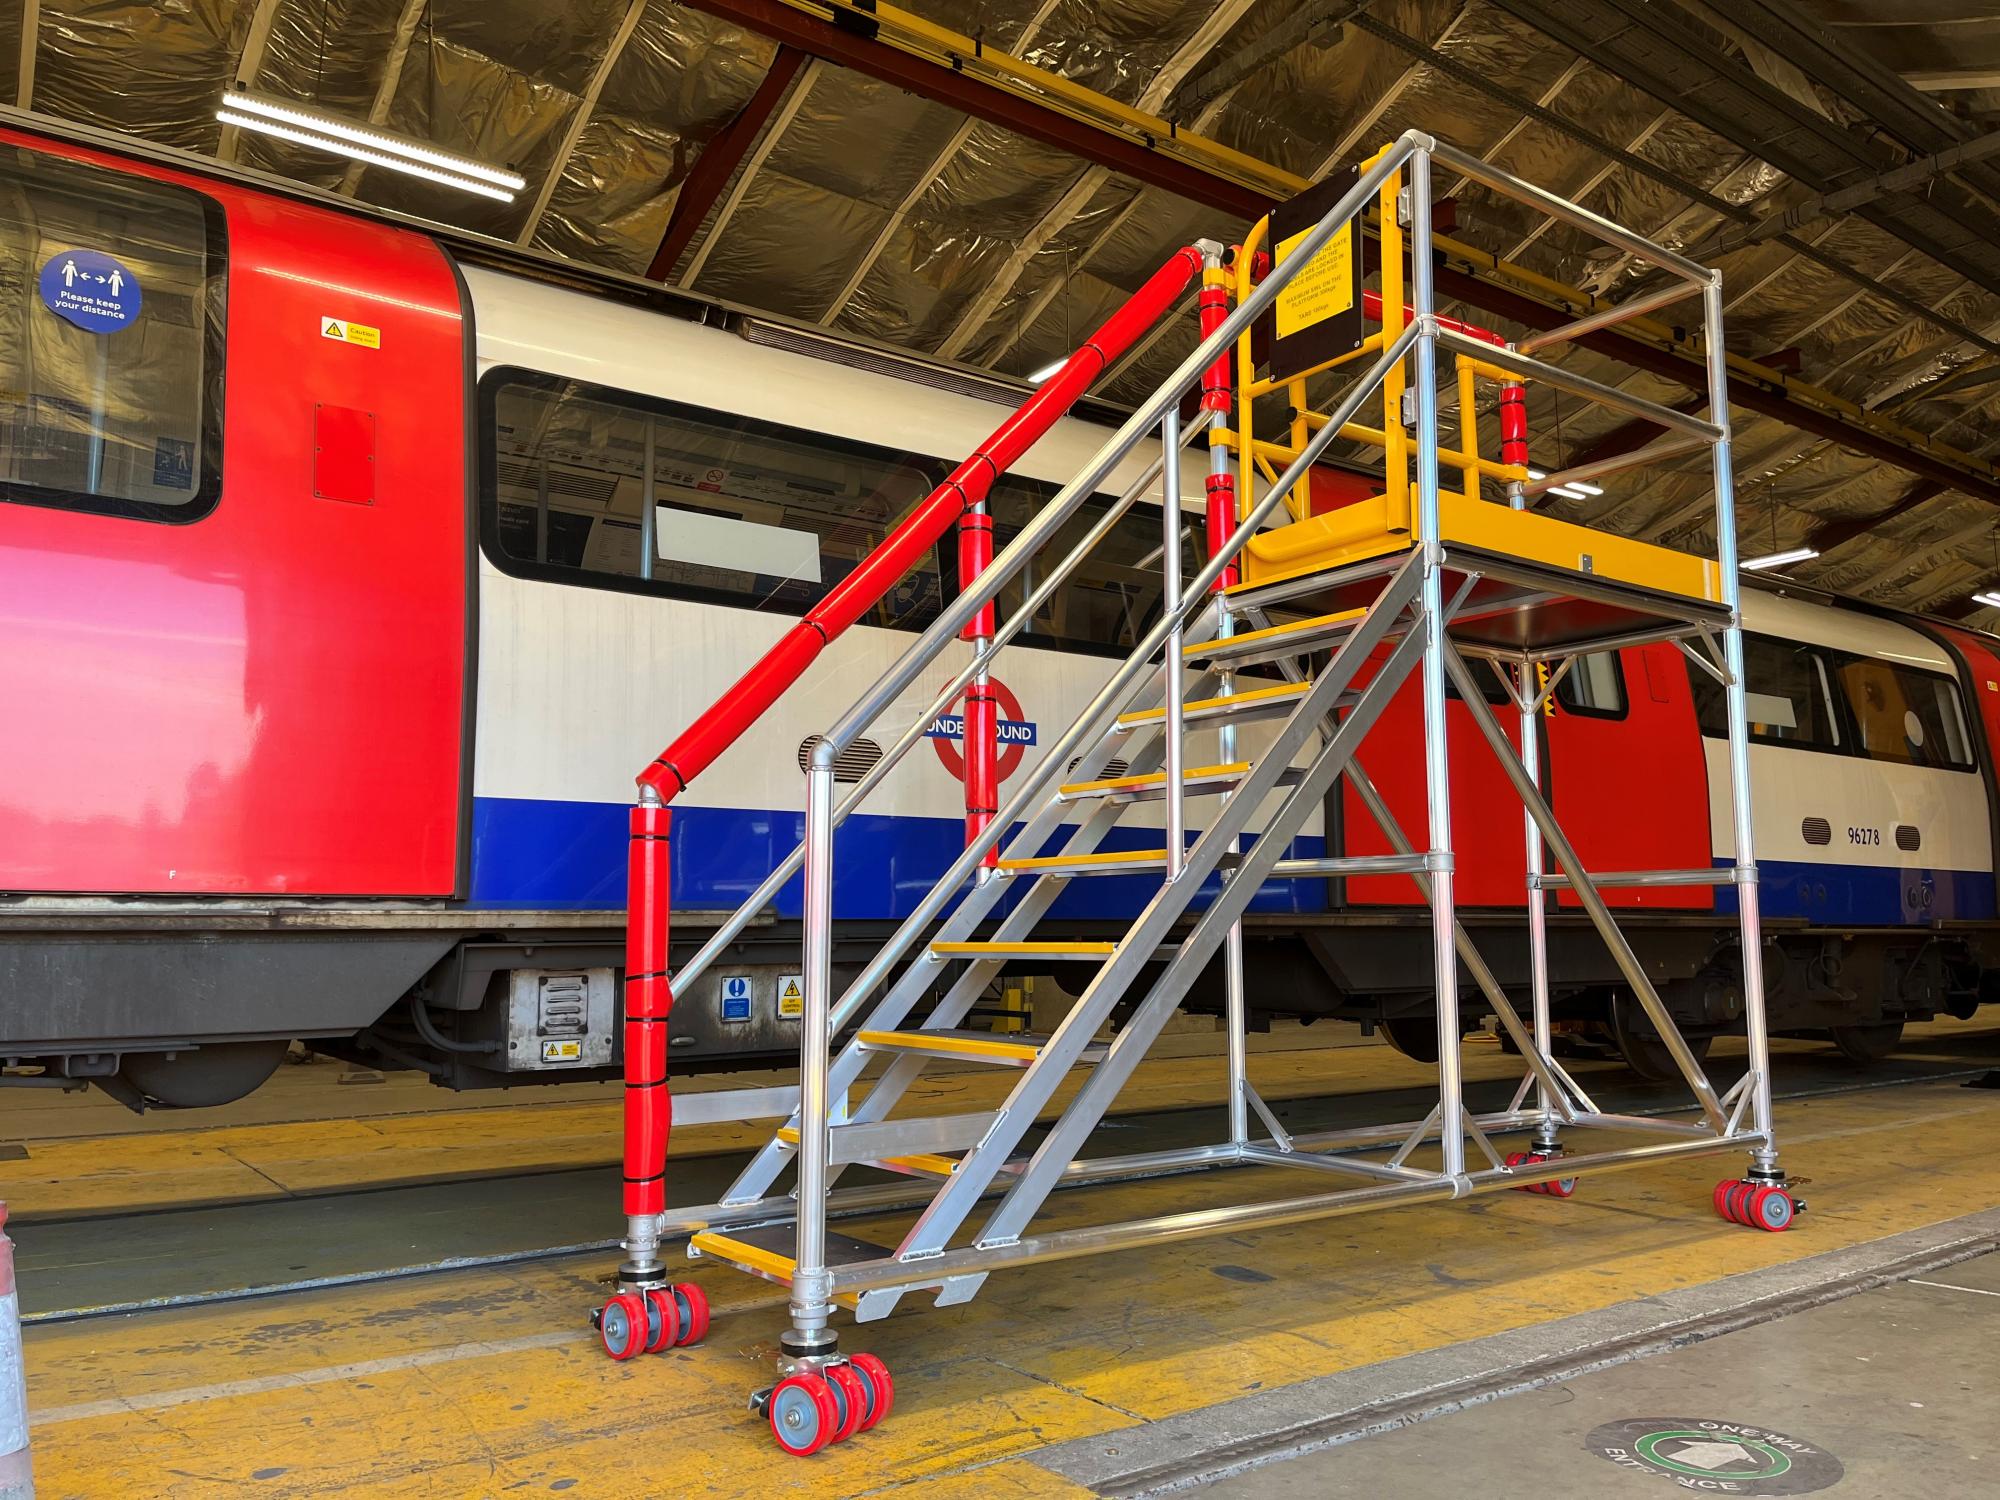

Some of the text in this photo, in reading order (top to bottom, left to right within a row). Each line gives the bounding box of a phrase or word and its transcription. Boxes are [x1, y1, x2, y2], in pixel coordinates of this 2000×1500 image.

[1332, 237, 1346, 248] GATE
[1304, 266, 1314, 275] ARE
[1316, 255, 1337, 270] LOCKED
[1315, 253, 1326, 263] AND
[55, 299, 125, 320] your distance
[60, 290, 121, 311] Please keep
[350, 327, 376, 338] Caution
[1847, 827, 1880, 845] 96278
[169, 870, 177, 880] F
[1698, 1421, 1817, 1454] ONE WAY
